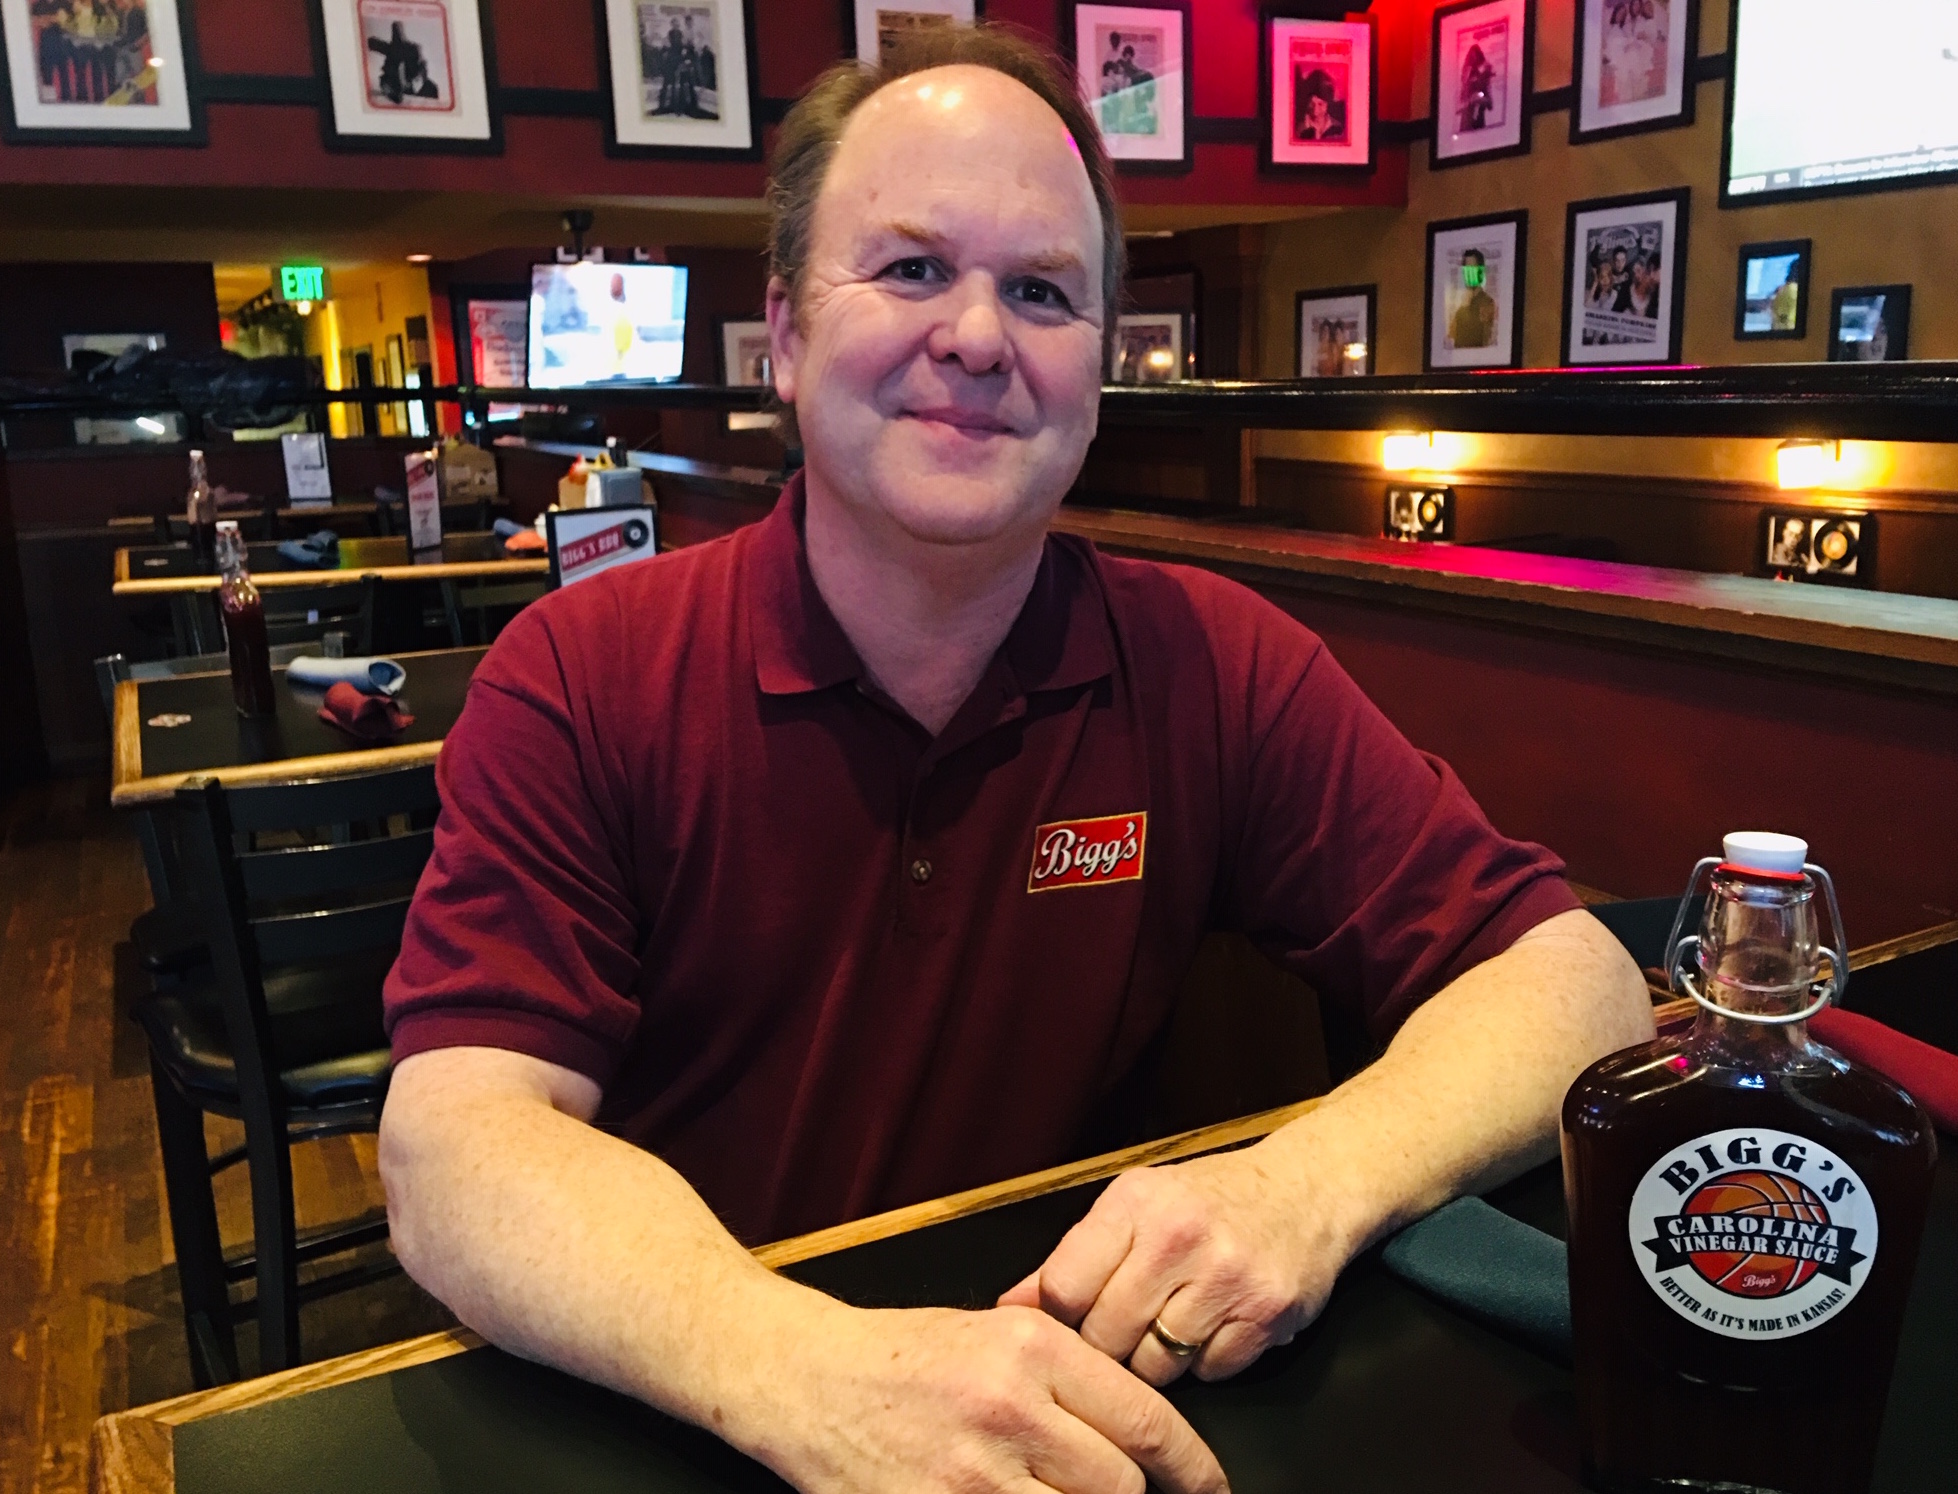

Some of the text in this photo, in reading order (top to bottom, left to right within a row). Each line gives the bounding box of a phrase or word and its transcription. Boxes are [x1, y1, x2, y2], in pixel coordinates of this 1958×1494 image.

[281, 266, 323, 301] EXIT
[1034, 821, 1138, 879] Bigg's
[1658, 1136, 1856, 1203] BIGG'S
[1667, 1216, 1839, 1247] CAROLINA
[1668, 1234, 1840, 1265] VINEGAR SAUCE
[1742, 1274, 1776, 1288] Bigg's
[1659, 1276, 1846, 1332] BETTER AS IT'S MADE IN KANSAS!
